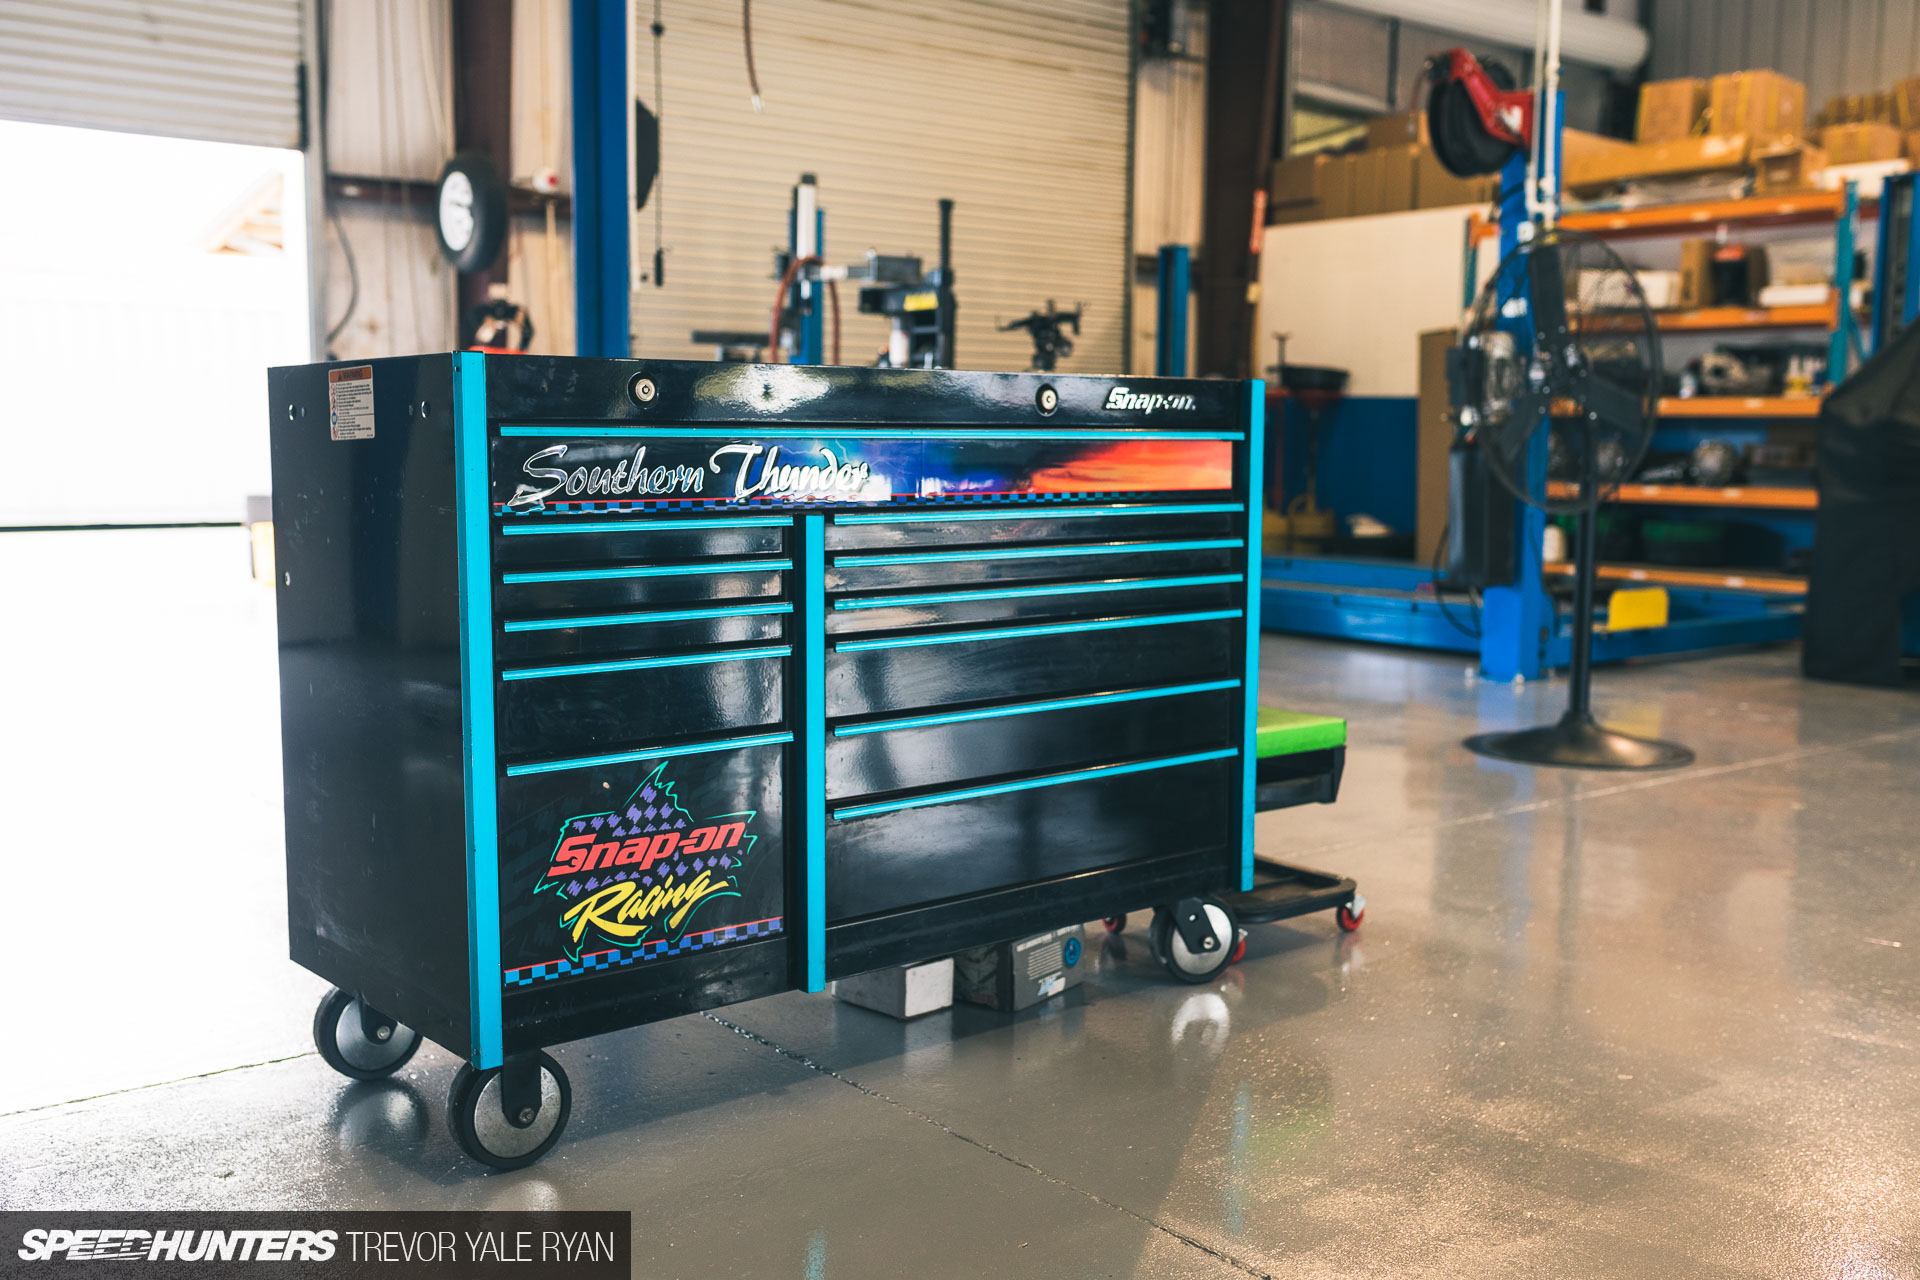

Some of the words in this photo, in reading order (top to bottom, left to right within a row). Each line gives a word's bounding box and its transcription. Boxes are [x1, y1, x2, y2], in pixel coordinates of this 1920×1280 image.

[507, 444, 704, 511] Southern
[709, 444, 870, 503] Thunder
[547, 821, 746, 878] Snap-on
[563, 870, 729, 943] Racing
